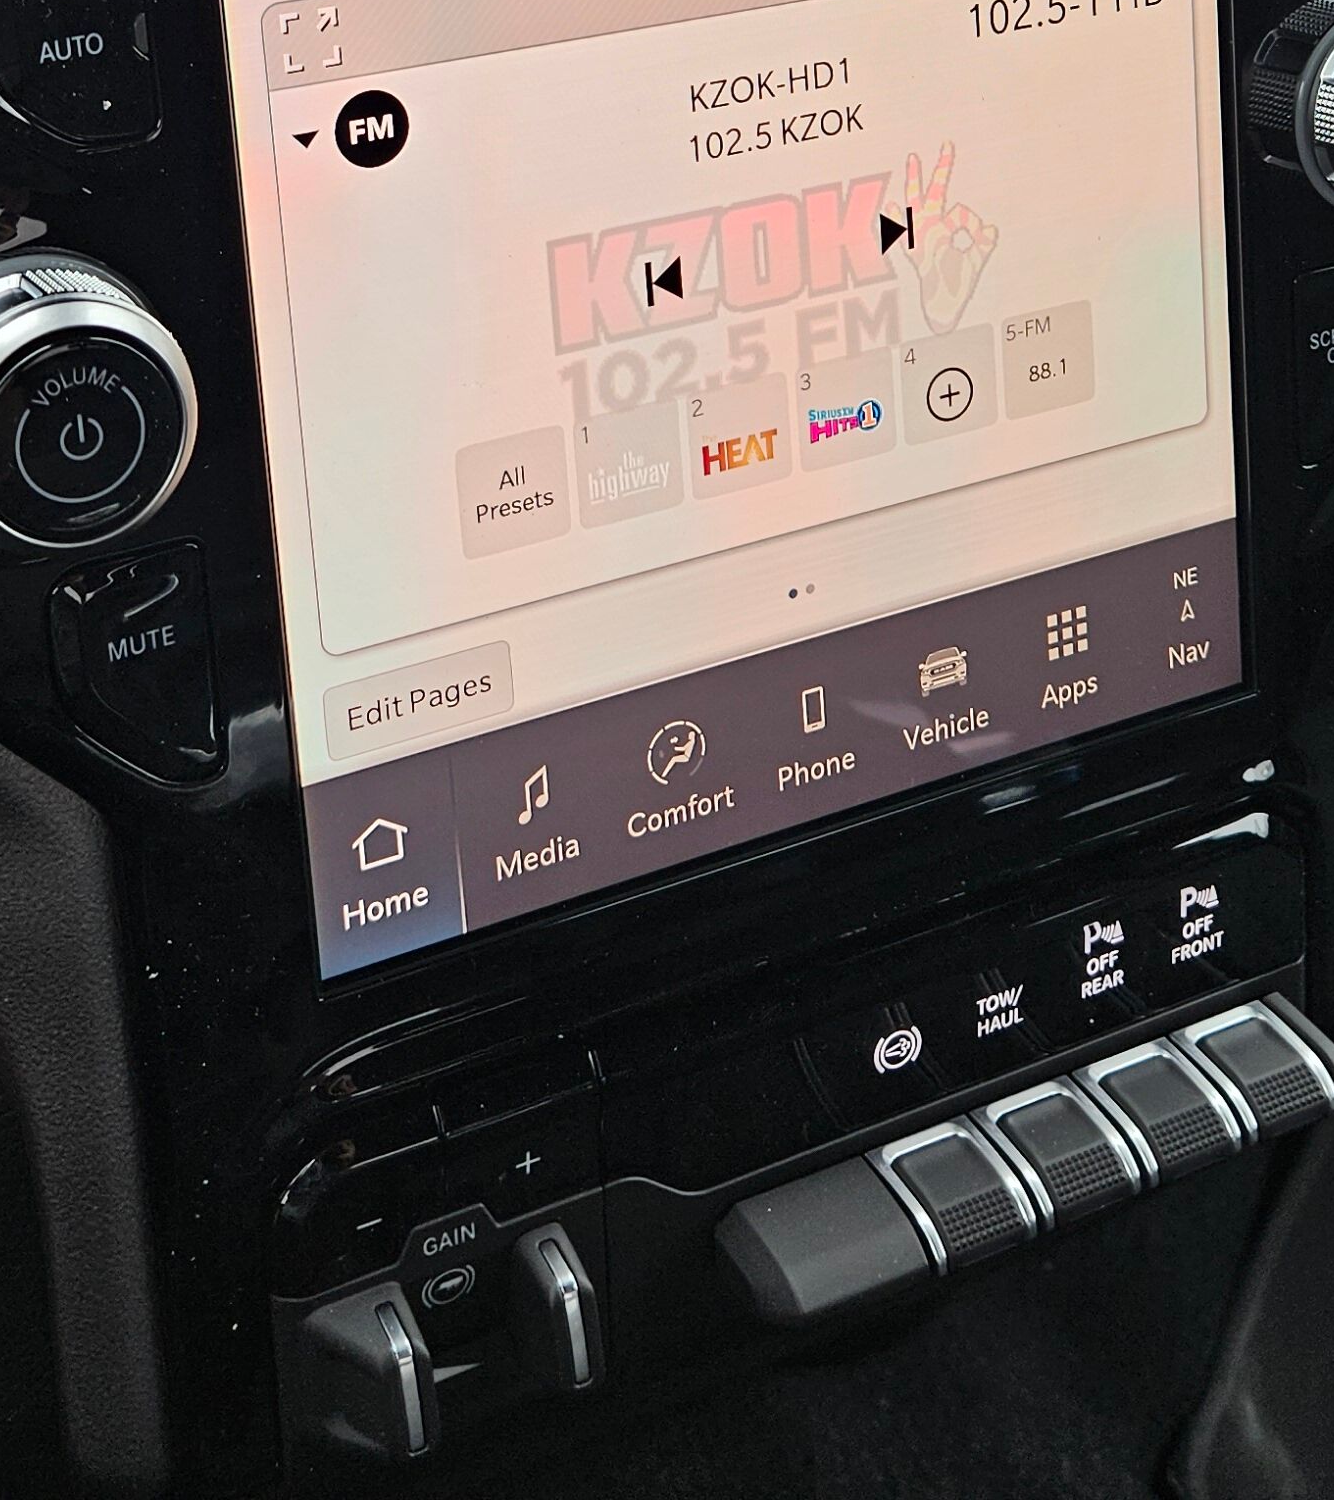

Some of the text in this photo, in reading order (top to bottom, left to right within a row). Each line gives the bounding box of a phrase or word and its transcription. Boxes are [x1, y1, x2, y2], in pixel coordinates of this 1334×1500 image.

[38, 32, 105, 65] AUTO
[689, 57, 852, 113] KZOK-HD1
[349, 113, 395, 146] FM
[689, 104, 865, 164] 102.5 KZOK
[546, 171, 898, 357] KZOK
[1006, 315, 1051, 342] 5-FM
[558, 287, 903, 422] 102.5 FM
[904, 348, 916, 365] 4
[1029, 357, 1067, 382] 88.1
[31, 366, 121, 409] VOLUME
[800, 373, 811, 391] 3
[691, 399, 704, 418] 2
[581, 426, 589, 444] 1
[623, 451, 643, 469] the
[702, 428, 778, 477] HEAT
[499, 465, 525, 490] All
[588, 462, 670, 501] highway
[476, 491, 554, 524] Presets
[1172, 566, 1199, 590] NE
[108, 625, 177, 663] MUTE
[1168, 640, 1211, 669] Nav
[347, 673, 492, 732] Edit Pages
[1041, 675, 1099, 709] Apps
[903, 708, 990, 751] Vehicle
[778, 751, 856, 791] Phone
[627, 785, 735, 839] Comfort
[495, 835, 581, 882] Media
[342, 884, 430, 931] Home
[1182, 914, 1214, 940] OFF
[1086, 950, 1119, 977] OFF
[1171, 930, 1224, 965] FRONT
[976, 984, 1024, 1016] TOW/
[1081, 969, 1124, 999] REAR
[977, 1007, 1024, 1038] HAUL
[423, 1222, 476, 1256] GAIN
